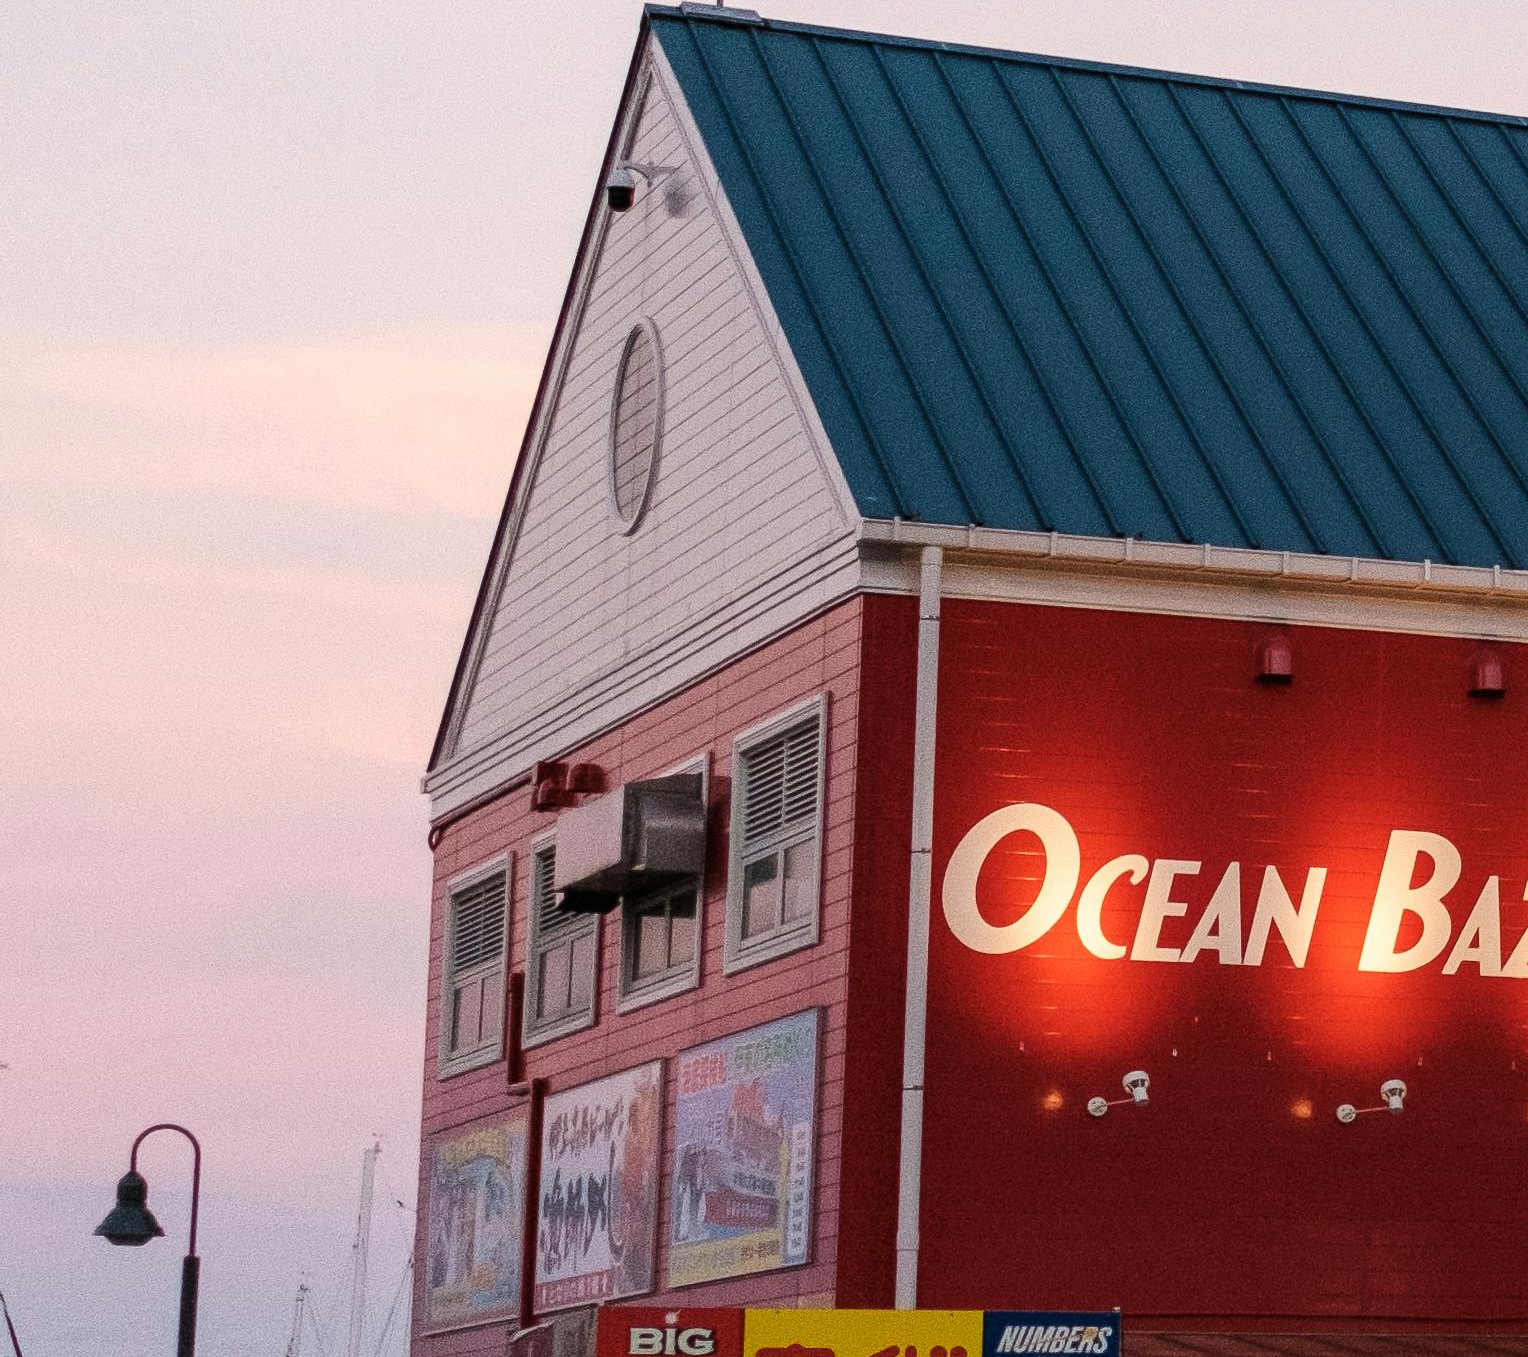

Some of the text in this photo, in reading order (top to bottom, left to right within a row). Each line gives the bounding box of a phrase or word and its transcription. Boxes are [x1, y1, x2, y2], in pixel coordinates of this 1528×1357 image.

[942, 803, 1326, 969] OCEAN
[628, 1326, 714, 1356] BIG
[996, 1324, 1113, 1356] NUMBERS
